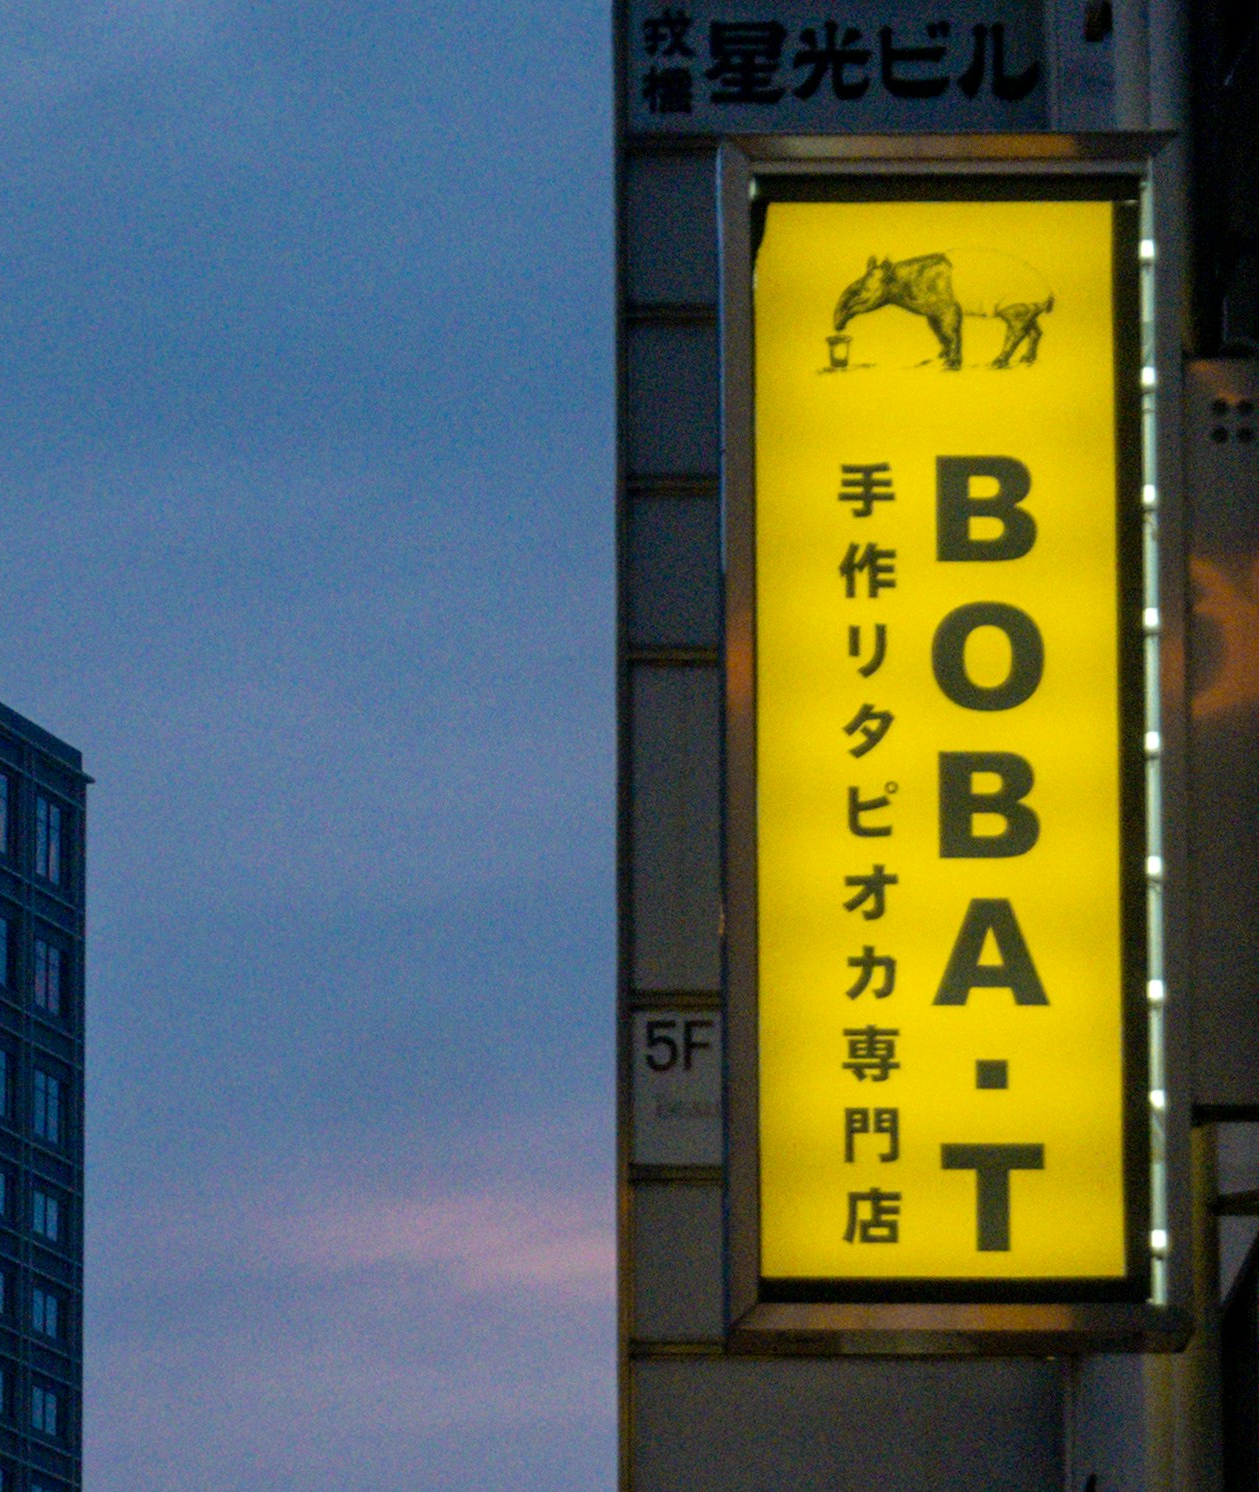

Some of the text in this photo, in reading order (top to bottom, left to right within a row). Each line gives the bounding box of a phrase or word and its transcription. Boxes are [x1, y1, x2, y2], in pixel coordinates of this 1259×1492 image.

[707, 20, 1039, 105] 星光ビル
[645, 1020, 714, 1072] 5F
